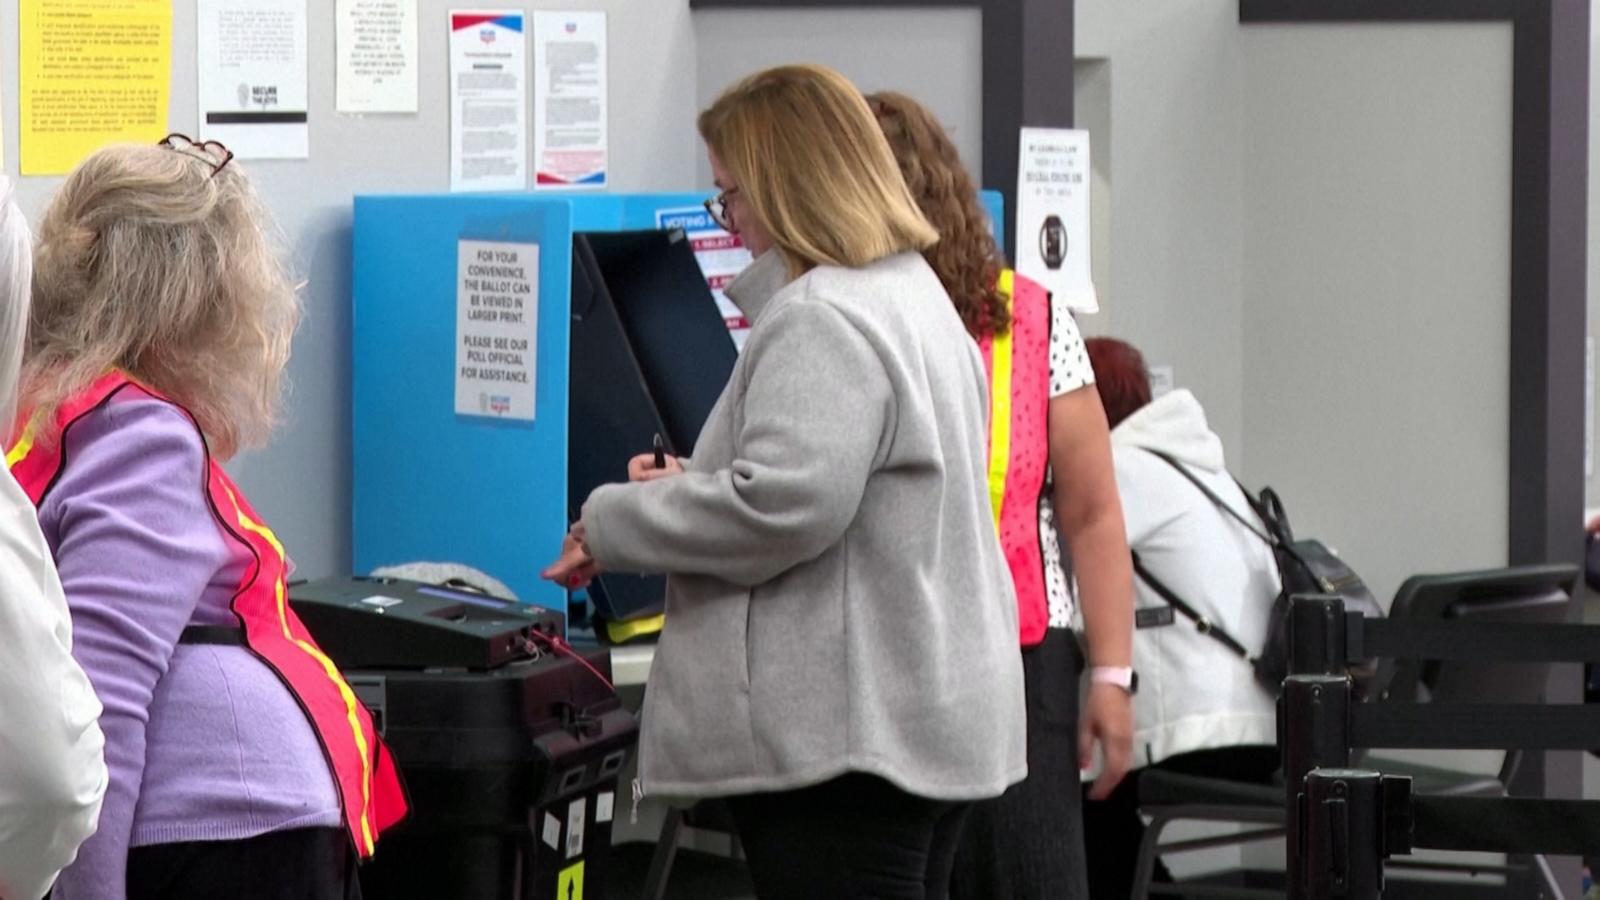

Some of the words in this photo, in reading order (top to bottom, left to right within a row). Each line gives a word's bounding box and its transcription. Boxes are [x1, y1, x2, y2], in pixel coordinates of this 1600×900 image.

[664, 214, 704, 229] VOTING
[477, 250, 493, 262] FOR
[495, 251, 518, 263] YOUR
[464, 279, 479, 291] THE
[481, 280, 511, 292] BALLOT
[512, 282, 531, 294] CAN
[470, 295, 480, 306] BE
[482, 296, 513, 308] VIEWED
[514, 298, 523, 309] IN
[467, 310, 498, 321] LARGER
[464, 335, 491, 348] PLEASE
[493, 337, 508, 349] SEE
[510, 339, 528, 351] OUR
[467, 350, 486, 362] POLL
[487, 352, 523, 365] OFFICIAL
[461, 367, 478, 379] FOR
